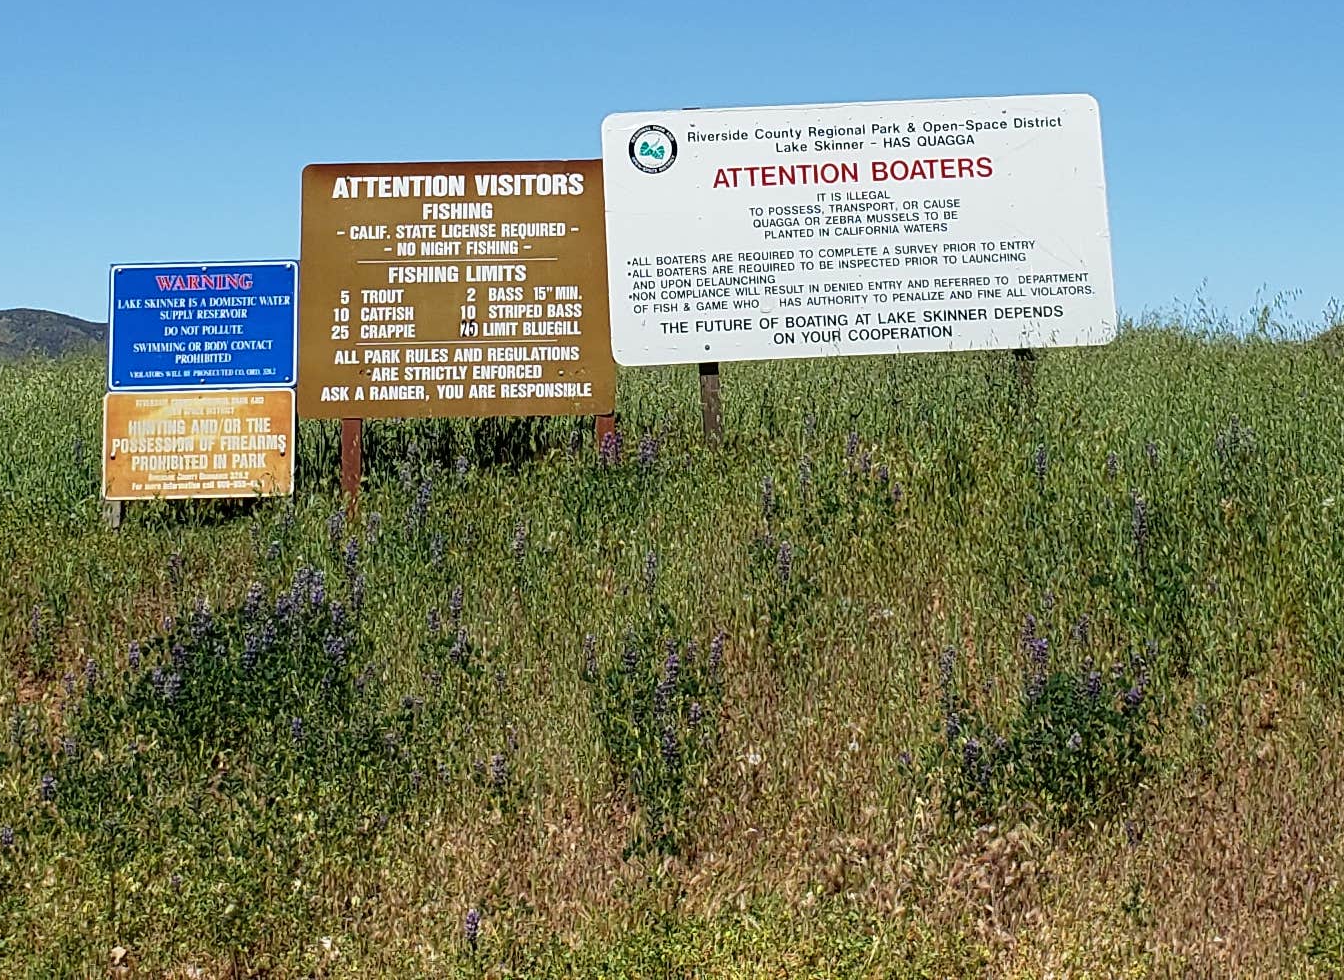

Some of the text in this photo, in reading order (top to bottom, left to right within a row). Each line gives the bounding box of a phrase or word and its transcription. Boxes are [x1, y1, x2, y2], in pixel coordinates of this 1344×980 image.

[688, 130, 748, 142] Riverside
[755, 128, 801, 140] County
[809, 124, 865, 138] Regional
[872, 124, 900, 134] Park
[907, 123, 915, 132] &
[923, 120, 1007, 134] Open-Space
[1014, 117, 1062, 128] District
[776, 142, 807, 152] Lake
[815, 140, 864, 151] Skinner
[884, 137, 910, 148] HAS
[918, 135, 974, 146] QUAGGA
[713, 157, 992, 188] ATTENTION BOATERS
[332, 173, 583, 198] ATTENTION VISITORS
[817, 191, 890, 202] IT IS ILLEGAL
[423, 203, 492, 220] FISHING
[749, 199, 960, 216] TO POSSESS, TRANSPORT, OR CAUSE
[753, 211, 958, 228] QUAGGA OR ZEBRA MUSSELS TO BE
[350, 223, 565, 239] CALIF. STATE LICENSE REQUIRED
[765, 223, 947, 239] PLANTED IN CALIFORNIA WATERS
[398, 241, 518, 256] NO NIGHT FISHING
[632, 240, 1035, 266] ALL BOATERS ARE REQUIRED TO COMPLETE A SURVEY PRIOR TO ENTRY
[156, 274, 253, 291] WARNING
[389, 265, 526, 283] FISHING LIMITS
[467, 288, 476, 301] 2
[489, 287, 523, 301] BASS
[556, 286, 582, 300] MIN.
[632, 273, 1088, 301] NON COMPLIANCE WILL RESULT IN DENIED ENTRY AND REFERRED TO DEPARTMENT
[118, 296, 290, 308] LAKE SKINNER IS A DOMESTIC WATER
[341, 290, 404, 304] 5 TROUT
[160, 309, 247, 320] SUPPLY RESERVOIR
[334, 307, 413, 322] 10 CATFISH
[461, 304, 582, 319] 10 STRIPED BASS
[660, 306, 1063, 334] THE FUTURE OF BOATING AT LAKE SKINNER DEPENDS
[164, 325, 242, 336] DO NOT POLLUTE
[332, 324, 415, 339] 25 CRAPPIE
[483, 322, 518, 336] LIMIT
[523, 321, 581, 335] BLUEGILL
[774, 326, 952, 344] ON YOUR COOPERATION
[134, 340, 272, 352] SWIMMING OR BODY CONTACT
[176, 353, 231, 364] PROHIBITED
[335, 347, 579, 364] ALL PARK RULES AND REGULATIONS
[372, 365, 542, 381] ARE STRICTLY ENFORCED
[321, 383, 592, 401] ASK A RANGER, YOU ARE RESPONSIBLE
[129, 418, 270, 436] HUNTING AND/OR THE
[112, 435, 286, 453] POSSESSION OF FIREARMS
[132, 453, 266, 470] PROHIBITED IN PARK
